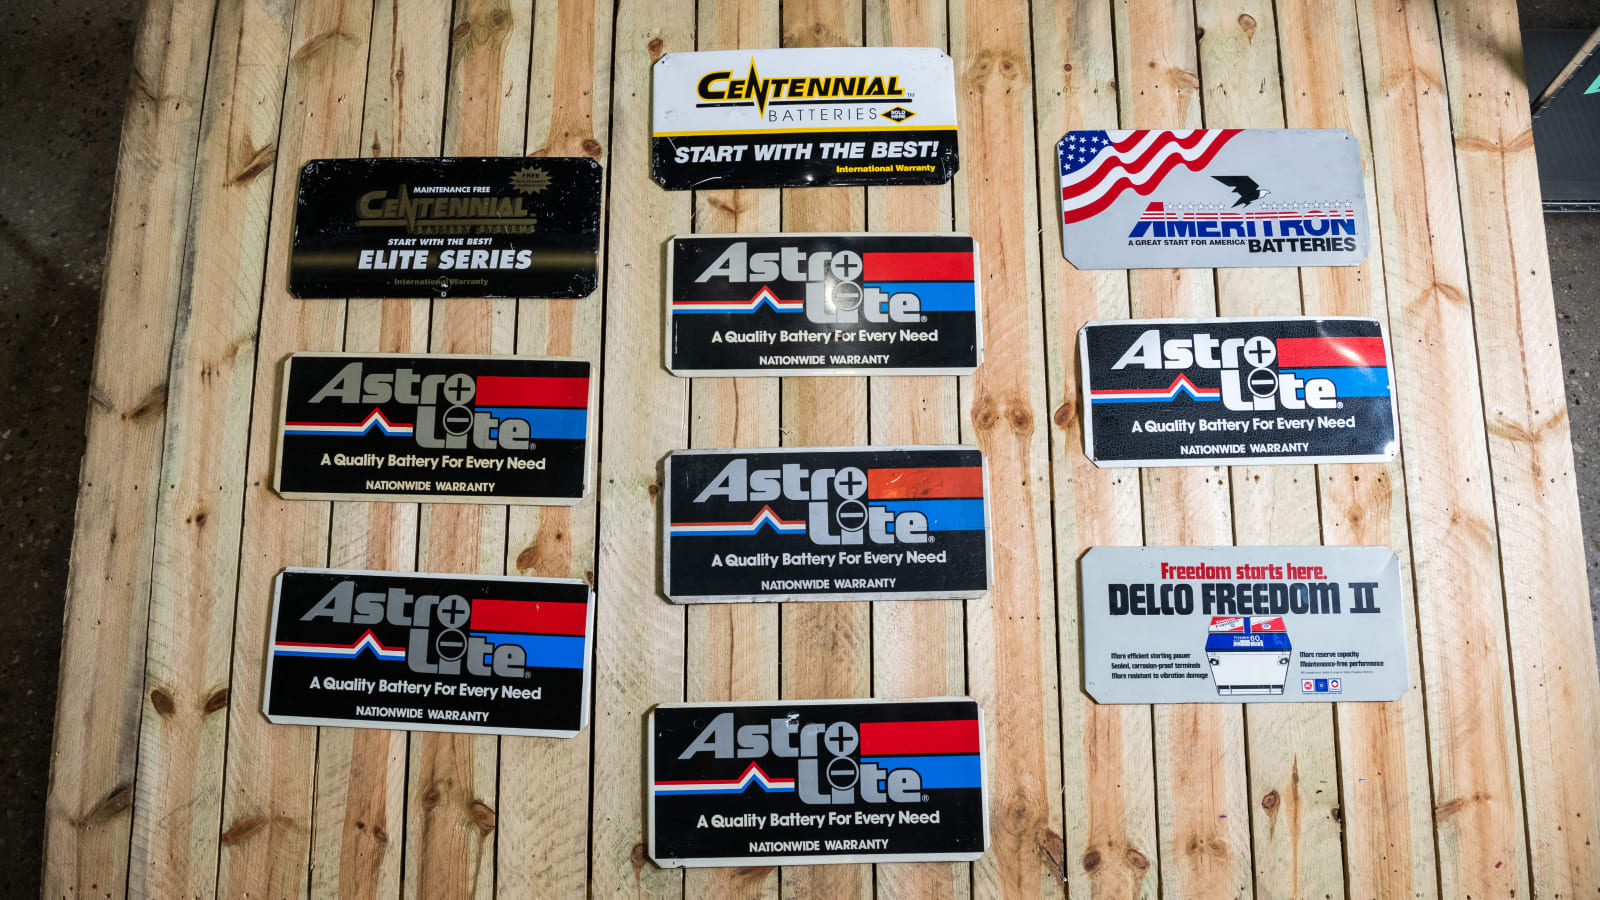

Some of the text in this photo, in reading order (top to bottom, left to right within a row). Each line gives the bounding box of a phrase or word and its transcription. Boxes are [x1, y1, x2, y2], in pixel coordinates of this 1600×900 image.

[696, 56, 906, 119] CENTENNIAL
[769, 107, 877, 122] BATTERIES
[675, 141, 939, 164] START WITH THE BEST!
[836, 165, 935, 174] International Warranty
[1128, 201, 1356, 238] AMERITRON
[388, 237, 492, 246] START WITH THE BEST!
[1249, 238, 1356, 253] BATTERIES
[358, 250, 532, 270] ELITE SERIES
[694, 242, 863, 283] Astro
[450, 278, 488, 286] Warranty
[712, 329, 938, 344] A Quality Battery For Every Need
[1111, 329, 1277, 369] Astro
[759, 354, 890, 365] NATIONWIDE WARRANTY
[308, 362, 476, 405] Astro
[1132, 416, 1355, 434] A Quality Battery For Every Need
[1180, 443, 1309, 455] NATIONWIDE WARRANTY
[320, 454, 545, 471] A Quality Battery For Every Need
[366, 480, 495, 492] NATIONWIDE WARRANTY
[693, 458, 867, 503] Astro
[712, 551, 947, 568] A Quality Battery For Every Need
[1161, 562, 1327, 579] Freedom starts here.
[761, 578, 896, 590] NATIONWIDE WARRANTY
[299, 581, 470, 629] Astro
[1109, 582, 1381, 615] DELCO FREEDOM II
[310, 677, 542, 700] A Quality Battery For Every Need
[356, 706, 489, 722] NATIONWIDE WARRANTY
[678, 712, 859, 759] Astro
[697, 810, 940, 829] A Quality Battery For Every Need
[749, 839, 889, 853] NATIONWIDE WARRANTY
